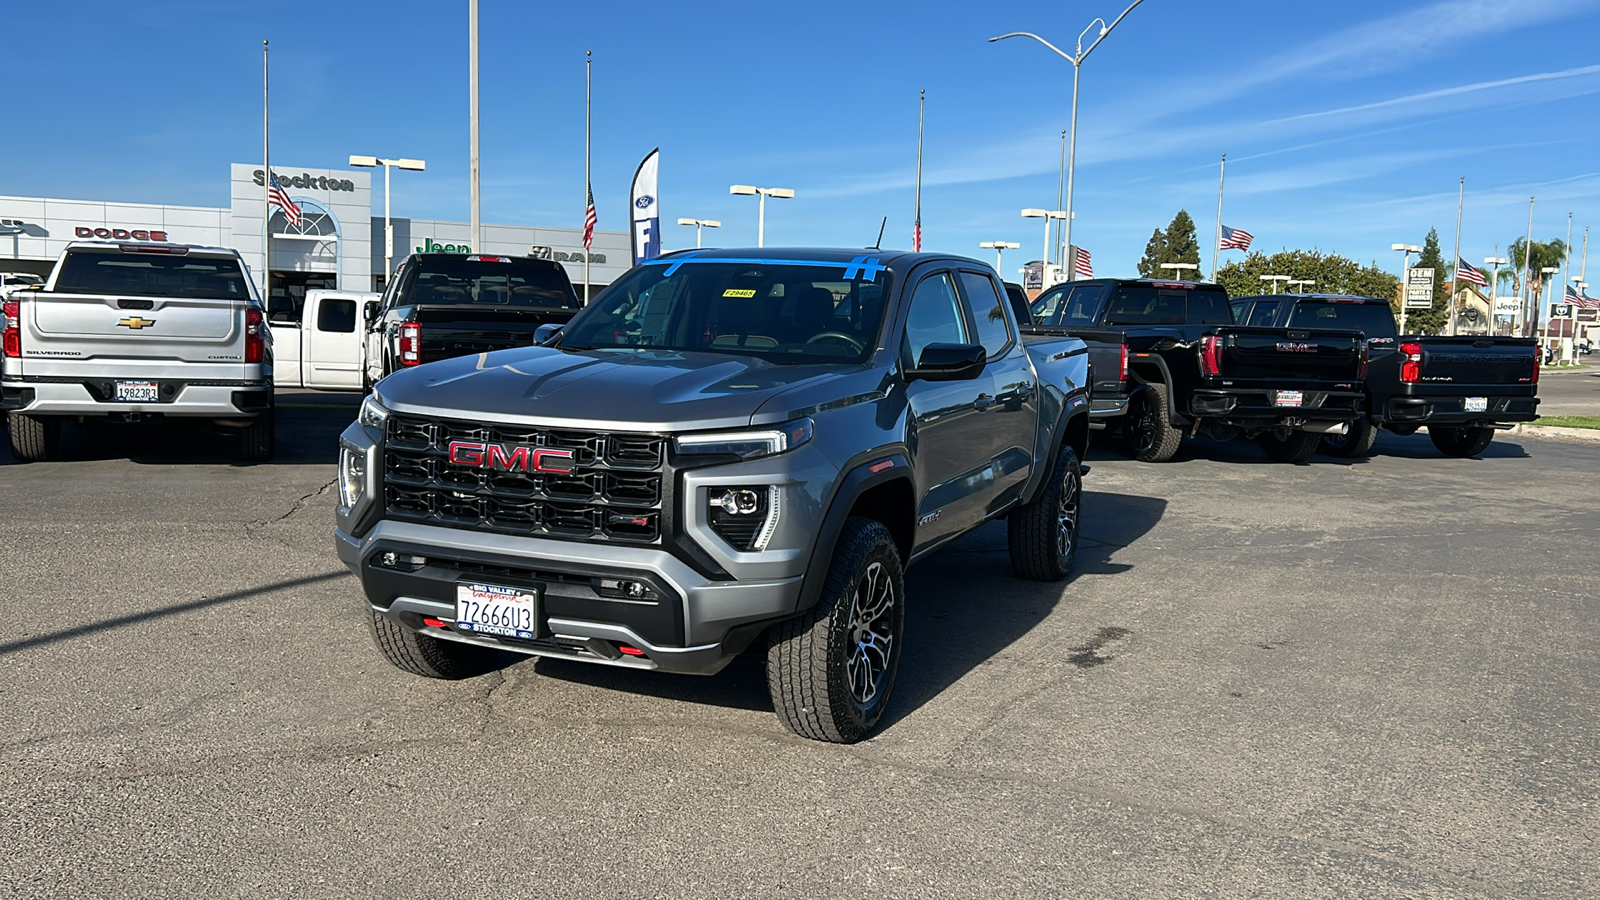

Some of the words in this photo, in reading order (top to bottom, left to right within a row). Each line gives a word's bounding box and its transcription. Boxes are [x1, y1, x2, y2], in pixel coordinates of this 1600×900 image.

[253, 170, 354, 192] Sockton
[75, 226, 168, 242] DODGE
[553, 251, 606, 263] RAM
[1497, 303, 1519, 311] Jeep
[1276, 342, 1318, 352] GMC
[119, 387, 156, 398] 19823R3
[448, 440, 577, 476] GMC
[473, 584, 488, 592] BIG
[488, 586, 516, 596] VALLEY
[461, 600, 531, 630] 72666U3
[472, 623, 517, 637] STOCKTON
